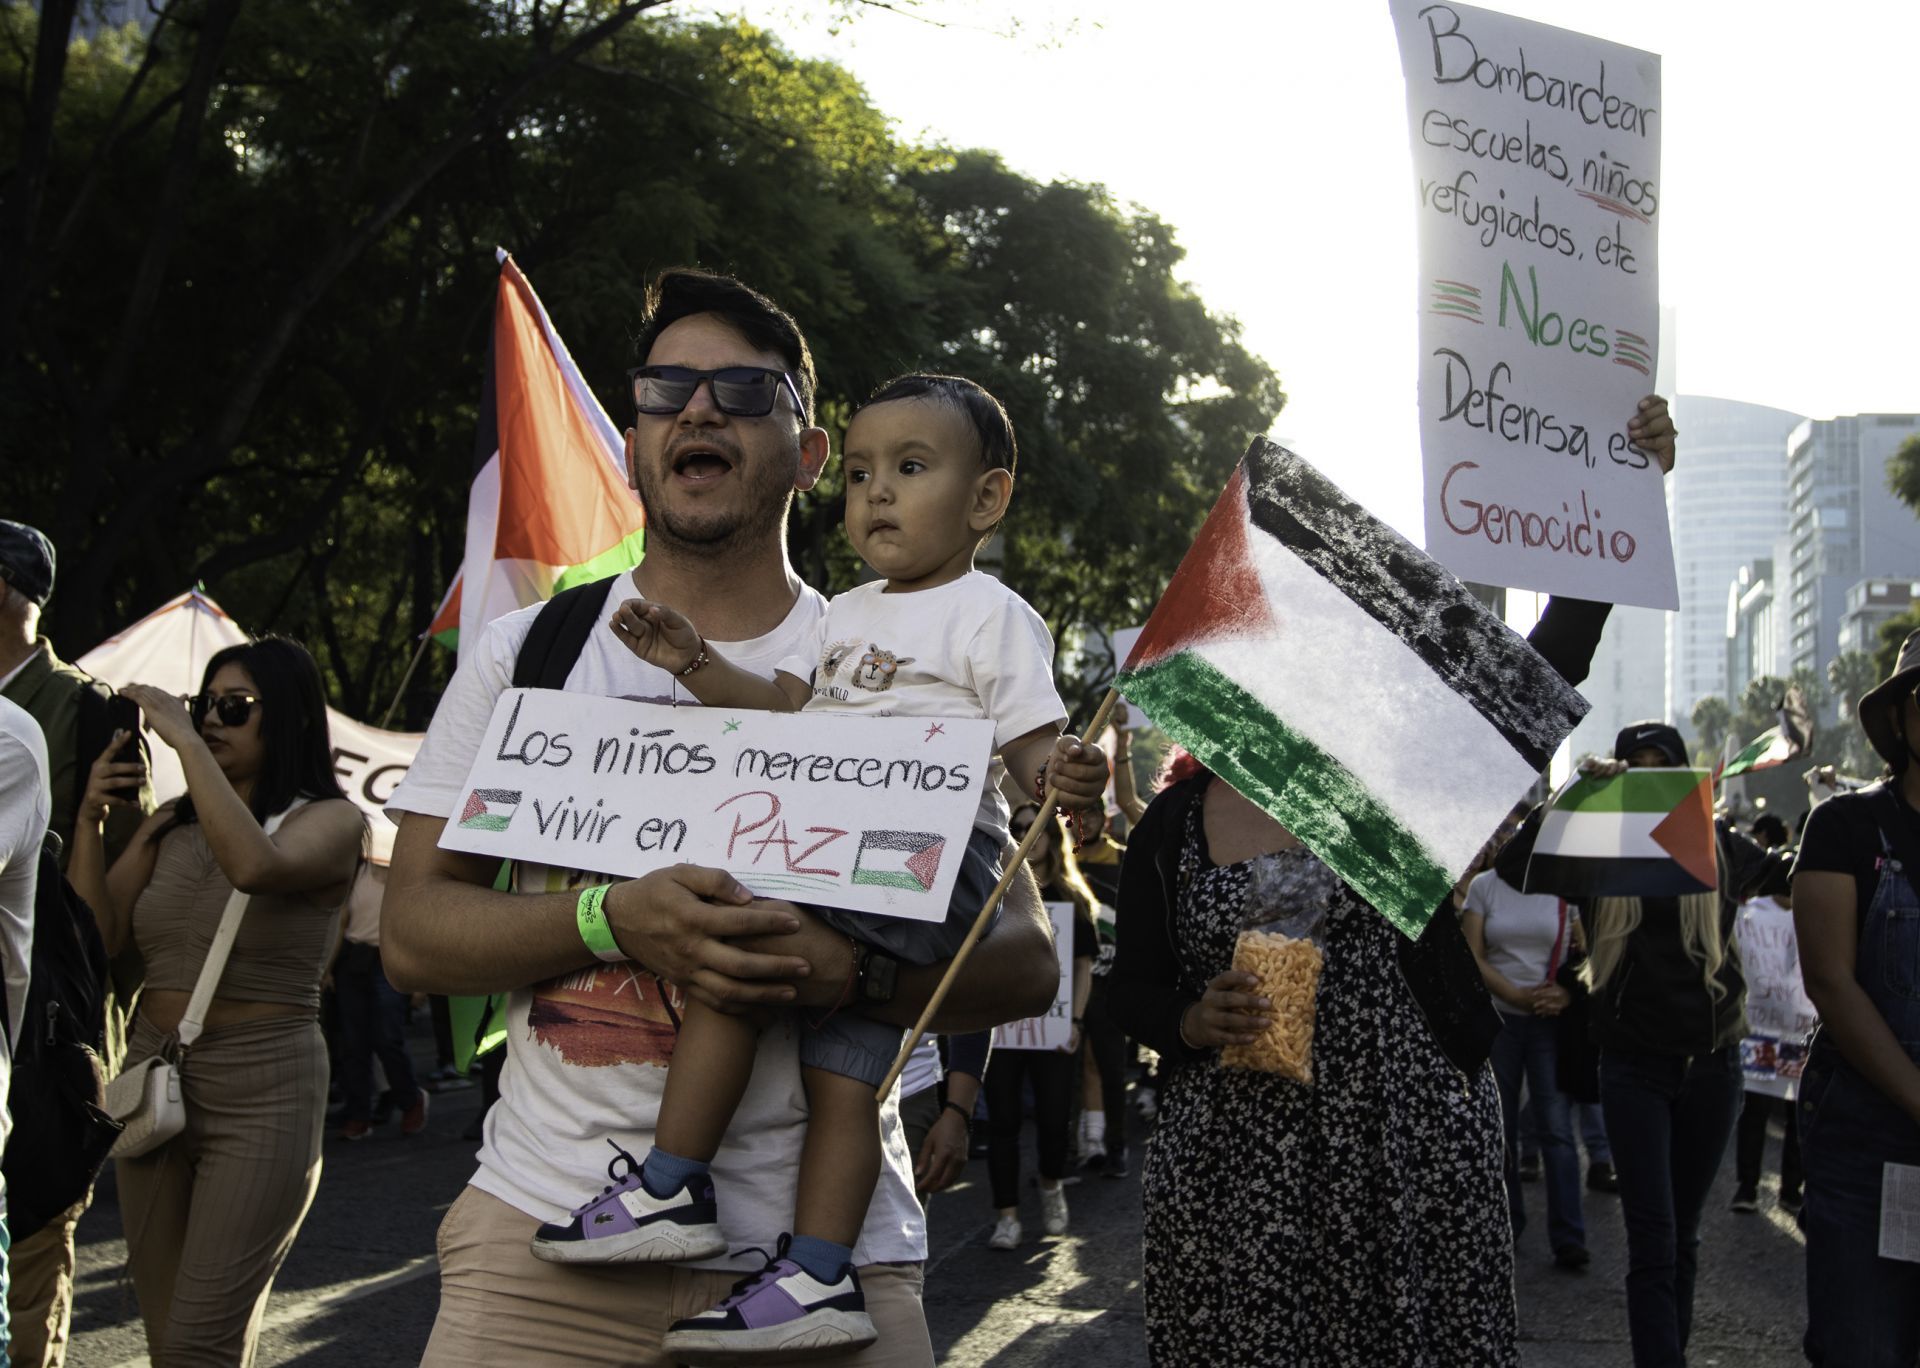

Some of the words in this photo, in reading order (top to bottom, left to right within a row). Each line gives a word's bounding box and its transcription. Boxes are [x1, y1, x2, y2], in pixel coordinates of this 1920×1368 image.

[1418, 5, 1657, 137] Bombardear
[1421, 109, 1575, 188] escuelas,
[1582, 150, 1658, 217] niños
[1419, 170, 1584, 261] refugiados,
[1595, 220, 1638, 274] etc
[1433, 347, 1597, 469] Defensa,
[1607, 432, 1650, 469] es
[1439, 460, 1637, 563] Genocidio
[497, 693, 573, 767] Los
[593, 727, 717, 775] niños
[735, 748, 970, 792] merecemos
[829, 686, 849, 701] WILD
[635, 817, 688, 853] en
[714, 790, 849, 877] PAZ
[660, 1229, 690, 1248] LACOSTE
